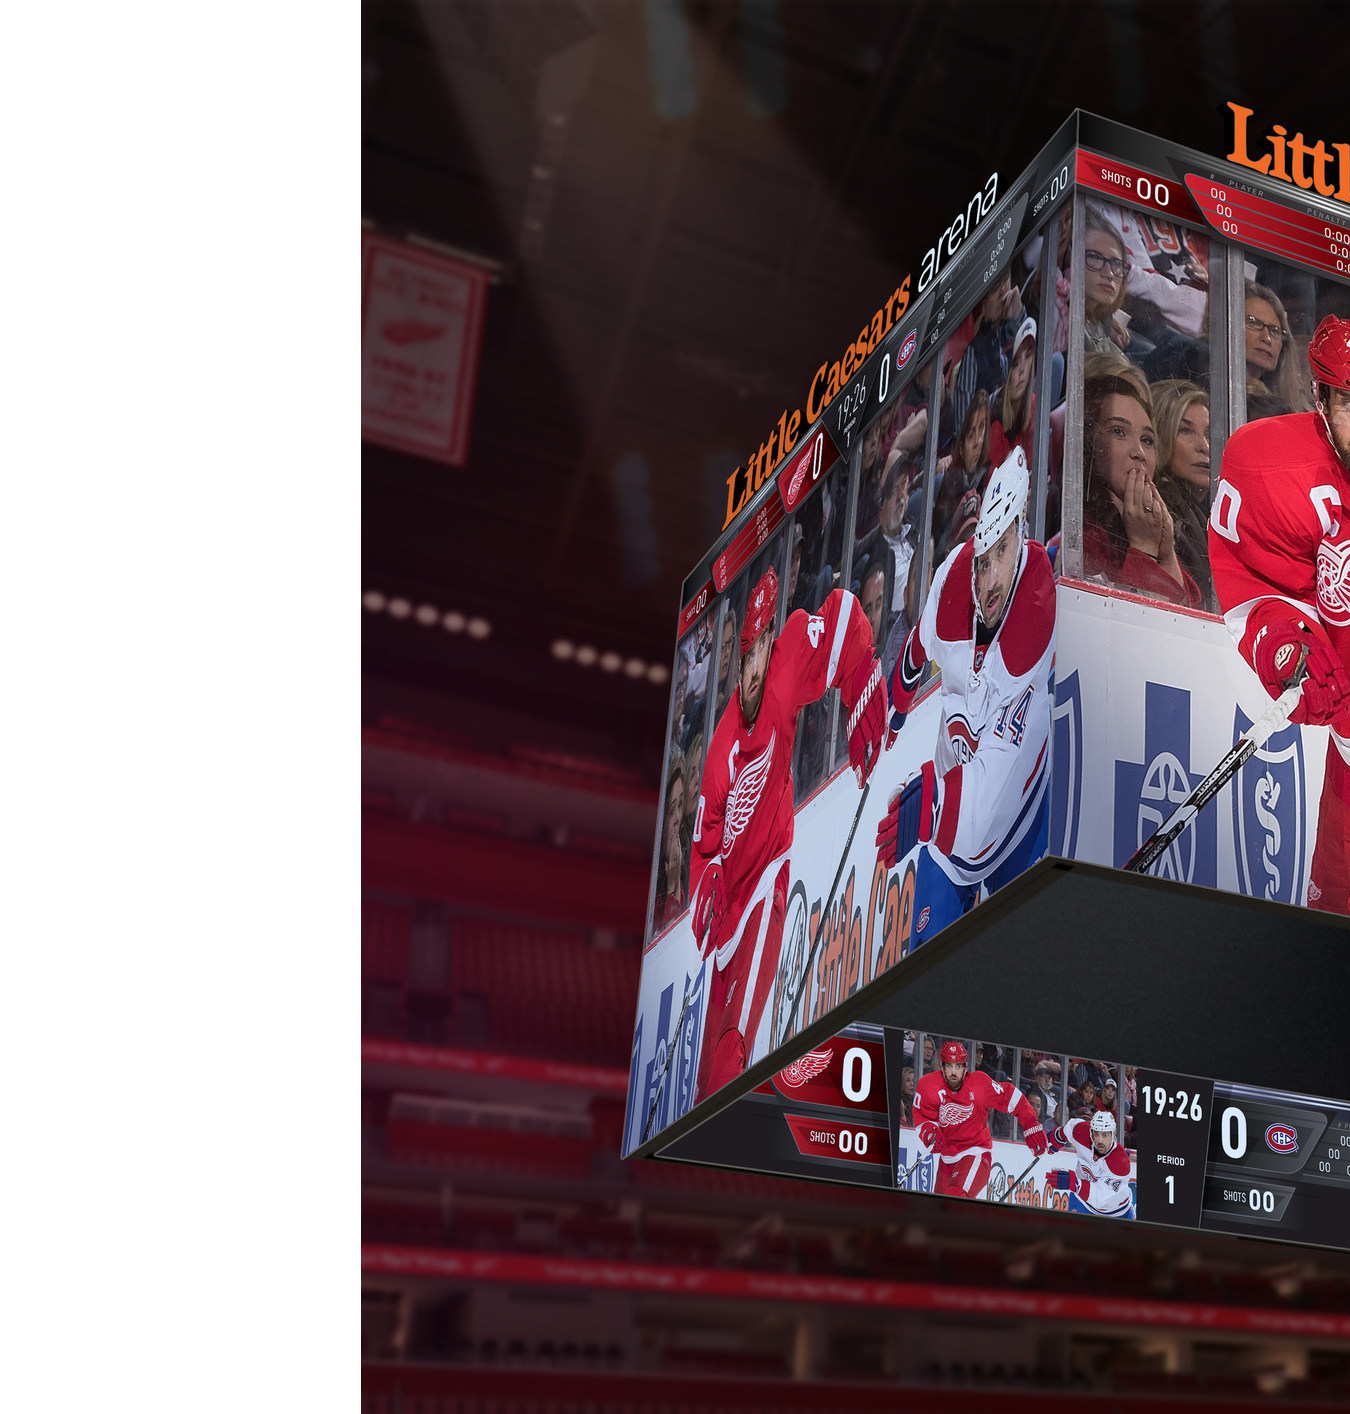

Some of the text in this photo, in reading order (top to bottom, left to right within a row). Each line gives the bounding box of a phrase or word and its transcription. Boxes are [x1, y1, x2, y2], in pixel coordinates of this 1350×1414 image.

[1033, 166, 1068, 217] SHOTS 00
[1101, 168, 1170, 207] SHOTS 00
[1229, 180, 1265, 198] PLAYER
[1307, 208, 1347, 226] PENALTY
[1210, 187, 1350, 246] 00 0:00
[1216, 204, 1232, 218] 00
[1222, 220, 1238, 235] 00
[721, 172, 998, 532] Little Caesars arena
[879, 353, 890, 403] 0
[838, 375, 866, 430] 19:26
[813, 432, 824, 480] 0
[1309, 484, 1342, 538] C
[696, 589, 707, 614] 00
[994, 684, 1035, 749] 14
[842, 1047, 872, 1103] 0
[1142, 1085, 1202, 1122] 19:26
[809, 1129, 868, 1155] SHOTS 00
[1221, 1106, 1248, 1159] 0
[1156, 1154, 1185, 1167] PERIOD
[1319, 1161, 1331, 1173] 00
[1328, 1148, 1340, 1160] 00
[1165, 1175, 1175, 1205] 1
[1223, 1189, 1275, 1213] SHOTS 00
